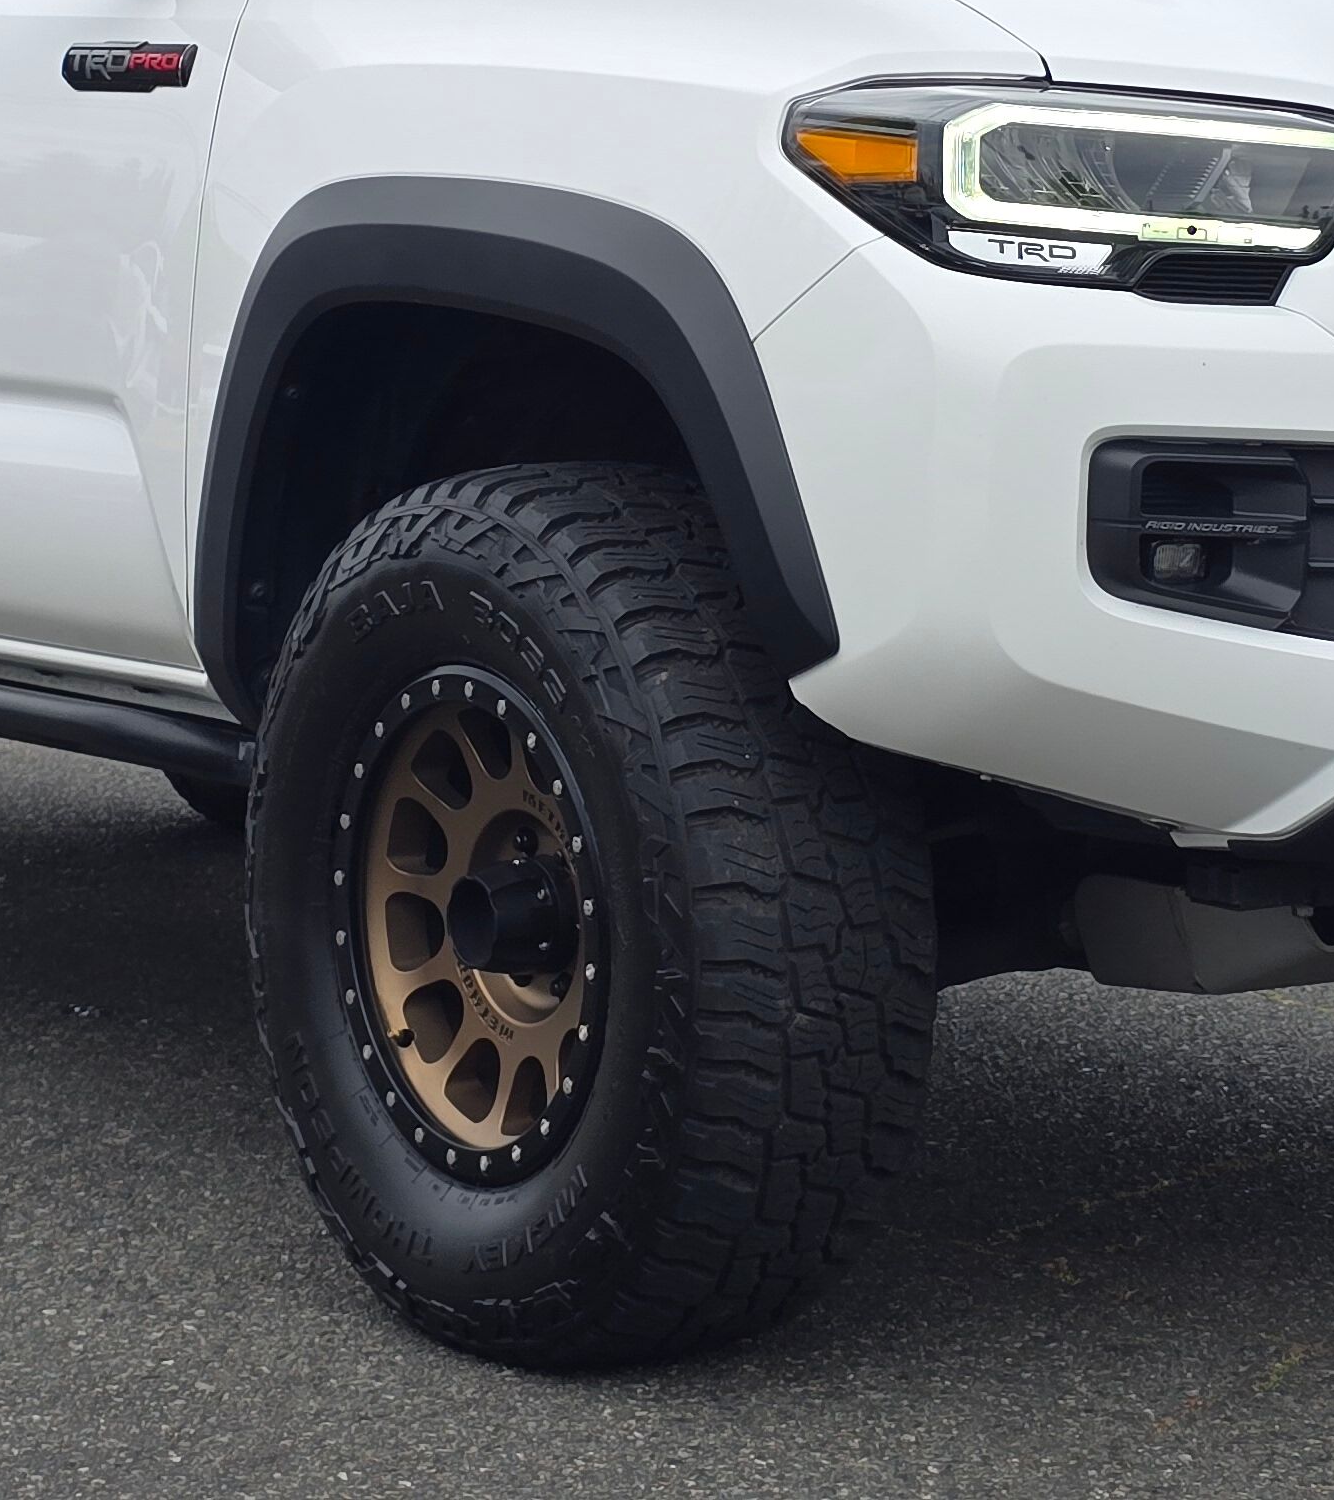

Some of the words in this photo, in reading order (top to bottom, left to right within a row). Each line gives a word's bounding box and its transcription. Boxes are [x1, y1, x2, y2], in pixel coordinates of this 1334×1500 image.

[68, 49, 132, 80] TRD
[129, 53, 181, 71] PRO
[987, 237, 1077, 262] TRD
